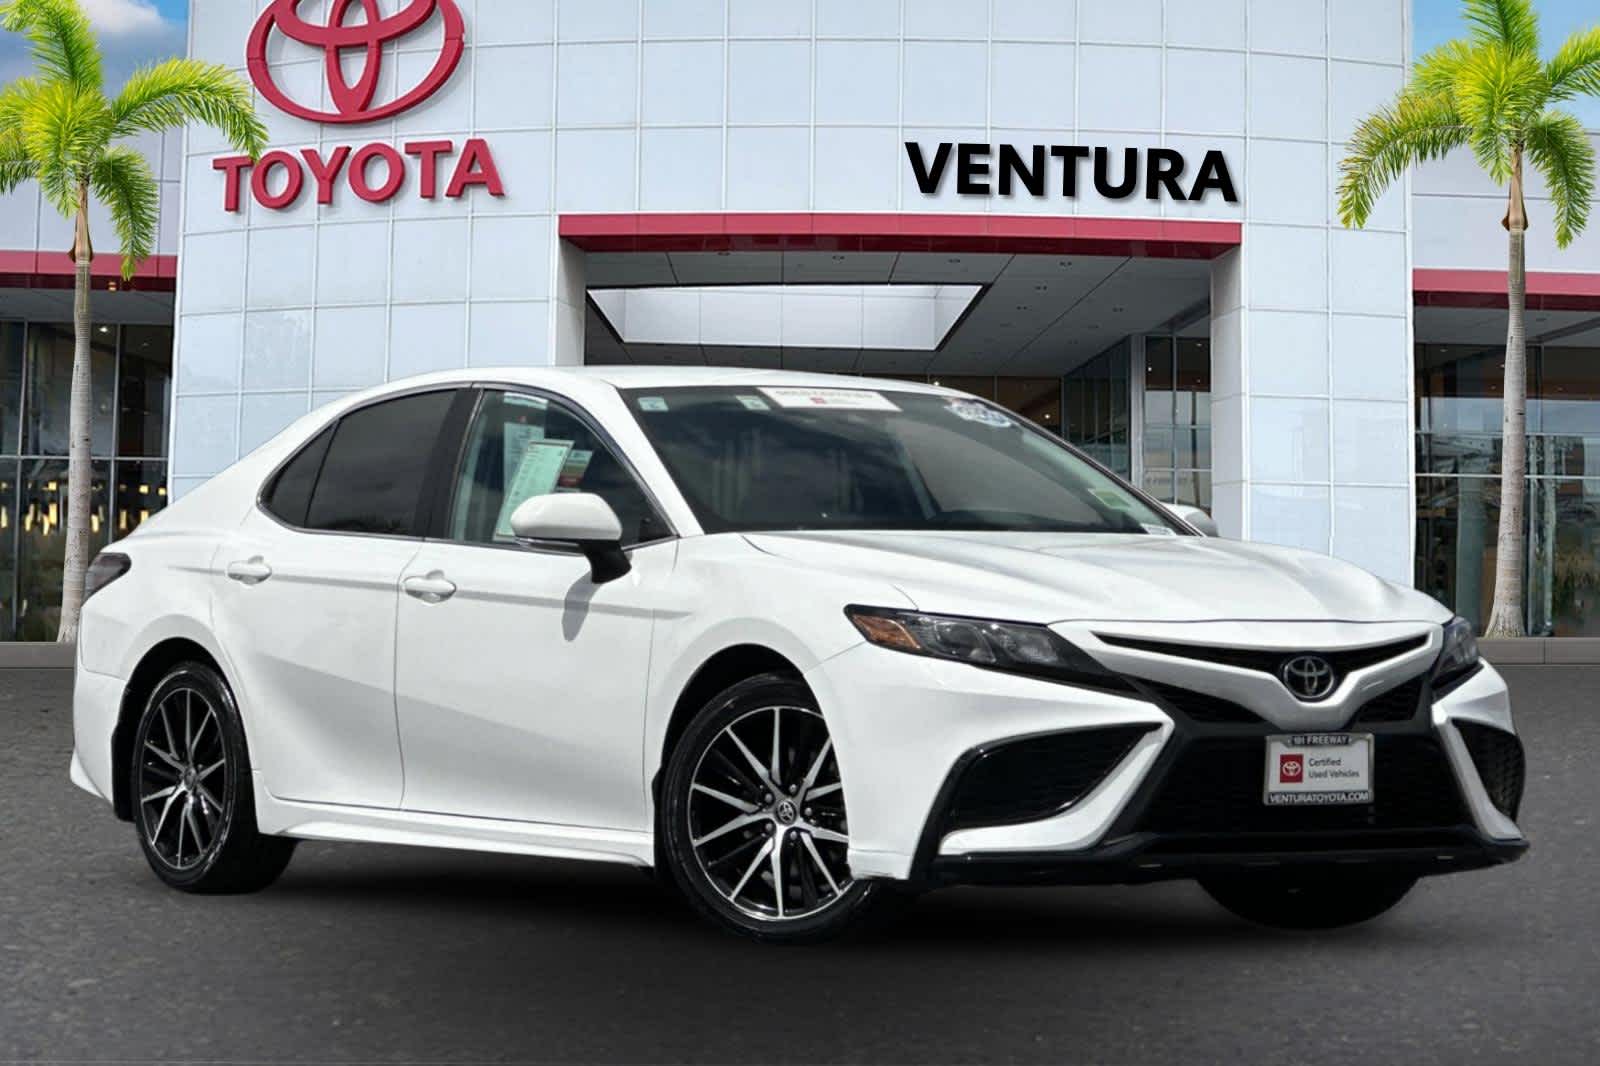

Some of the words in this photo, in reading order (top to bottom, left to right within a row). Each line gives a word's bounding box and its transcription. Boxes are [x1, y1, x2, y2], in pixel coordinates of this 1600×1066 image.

[212, 138, 505, 212] TOYOTA
[904, 141, 1238, 203] VENTURA
[1307, 736, 1347, 745] FREEWAY
[1309, 758, 1341, 767] Certified
[1309, 770, 1328, 779] Used
[1330, 769, 1360, 779] Vehicles
[1270, 792, 1369, 803] VENTURATOYOTA.COM
